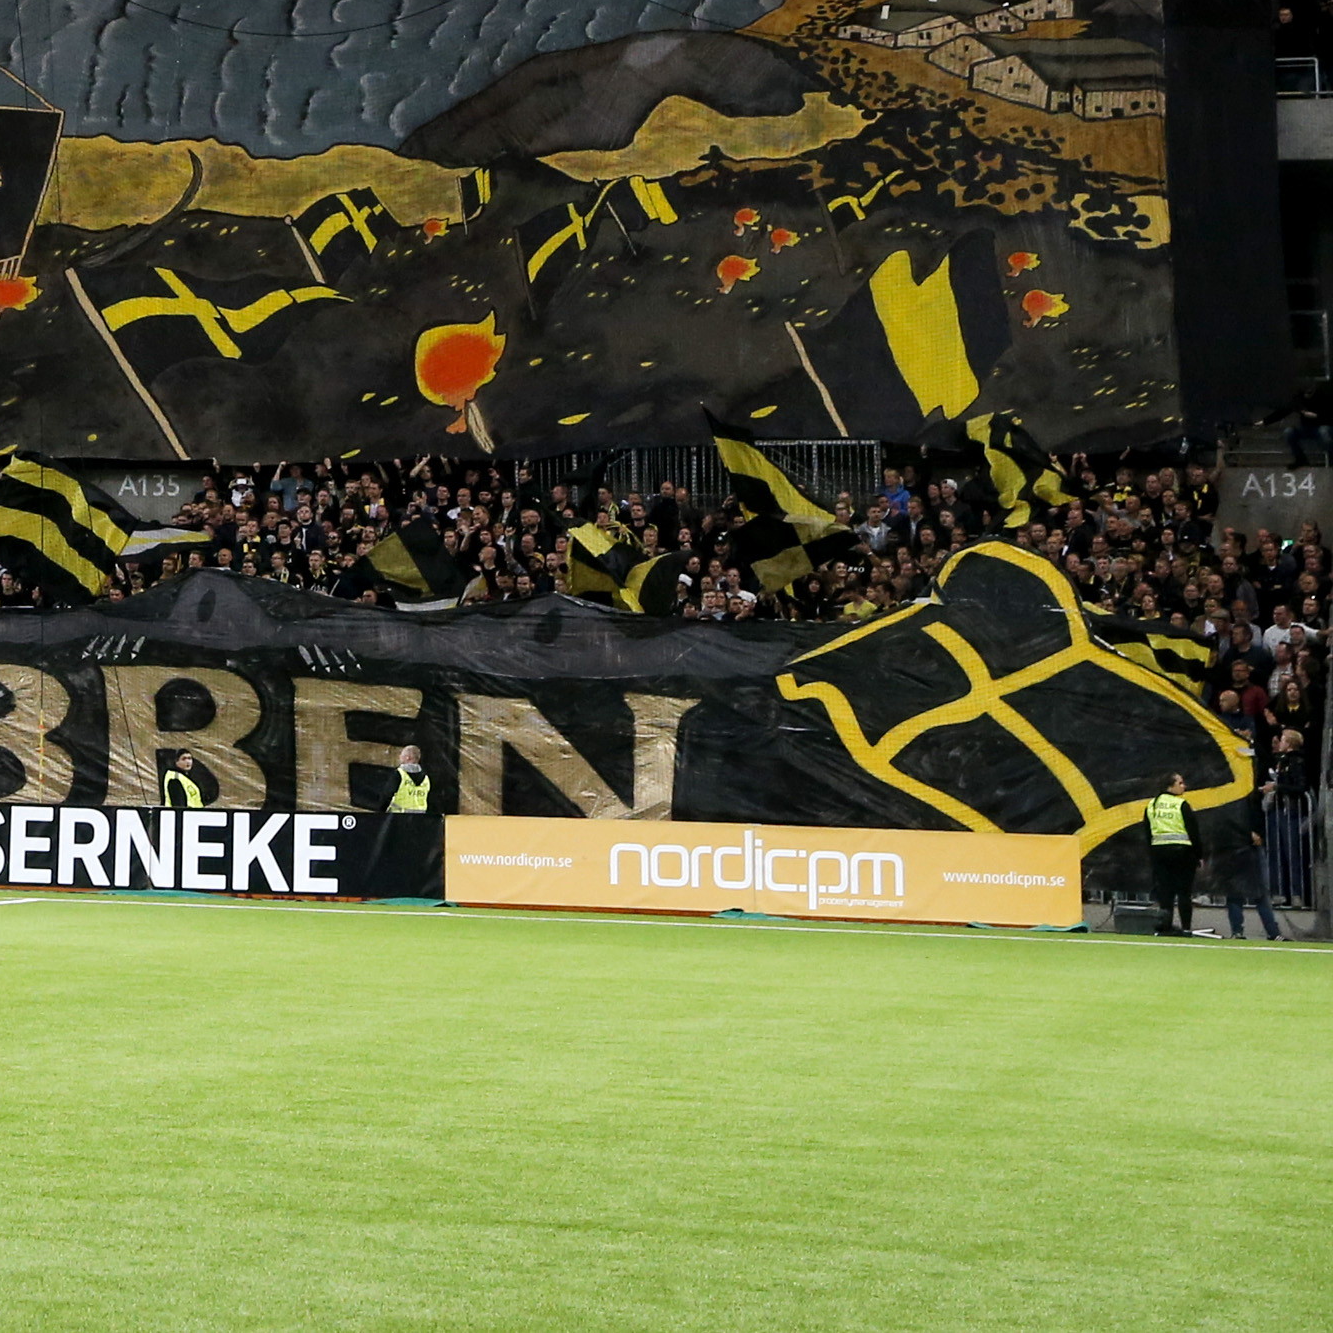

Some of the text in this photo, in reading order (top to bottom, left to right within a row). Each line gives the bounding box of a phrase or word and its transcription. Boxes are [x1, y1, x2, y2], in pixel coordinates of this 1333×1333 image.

[117, 474, 181, 497] A135
[1241, 472, 1316, 498] A134
[459, 851, 573, 870] www.nordicpm.se
[942, 868, 1066, 888] www.nordicpm.se
